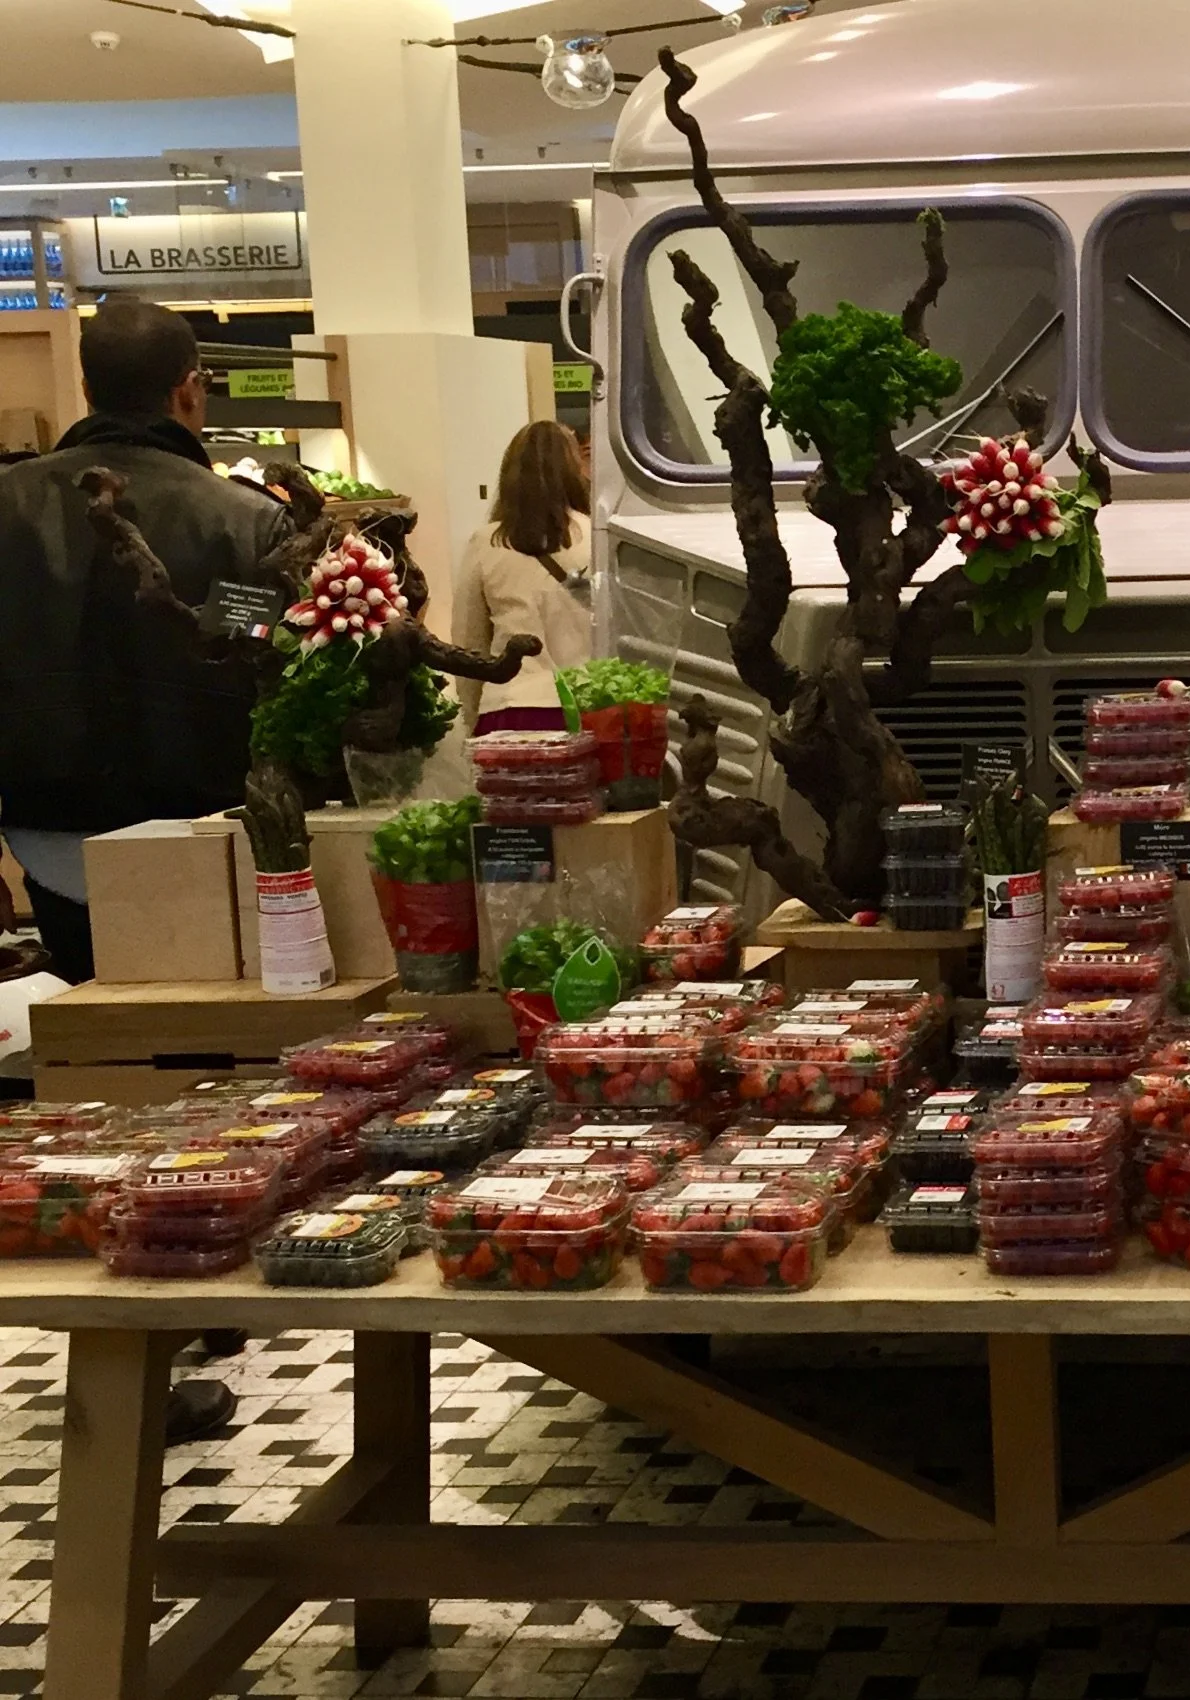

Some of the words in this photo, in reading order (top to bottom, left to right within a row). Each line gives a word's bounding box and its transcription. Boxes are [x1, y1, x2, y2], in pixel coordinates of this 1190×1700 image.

[110, 249, 142, 269] LA
[151, 245, 289, 268] BRASSERIE
[247, 374, 276, 382] FRUITS
[277, 374, 288, 382] ET
